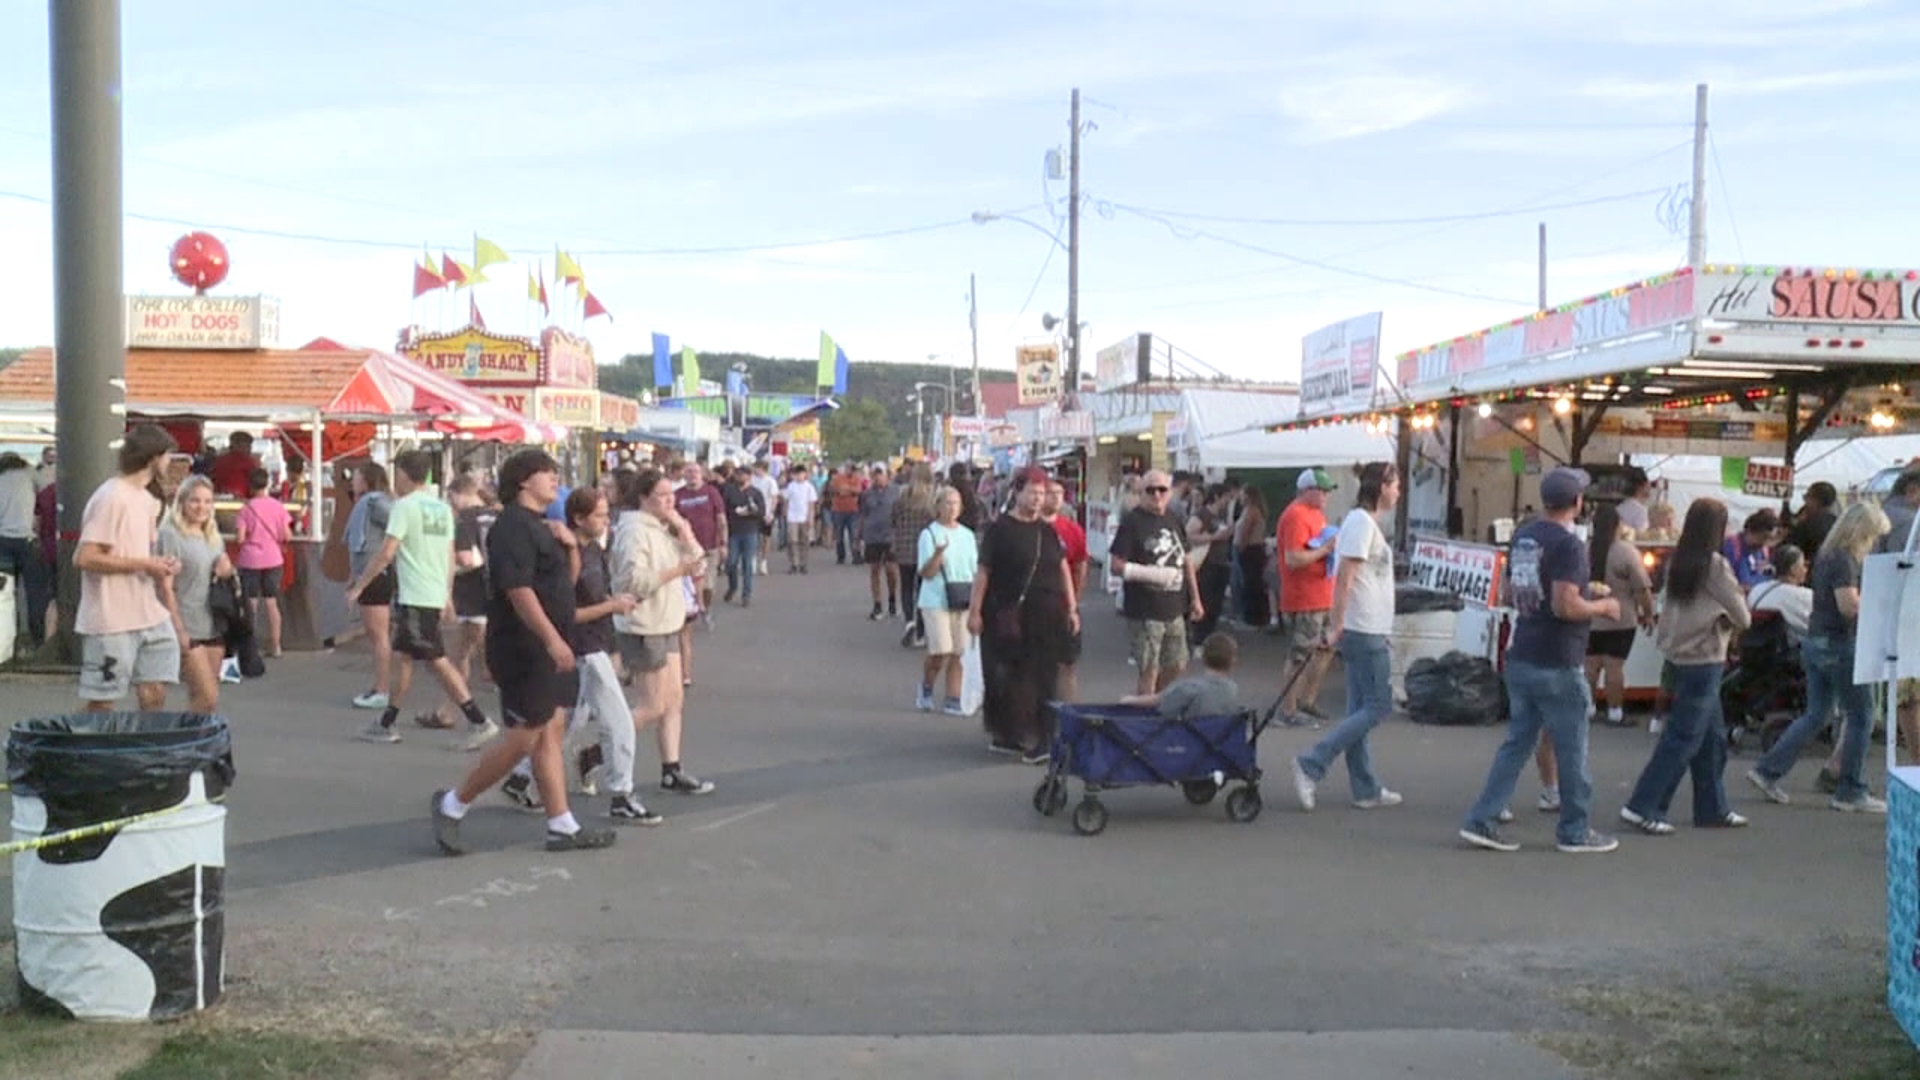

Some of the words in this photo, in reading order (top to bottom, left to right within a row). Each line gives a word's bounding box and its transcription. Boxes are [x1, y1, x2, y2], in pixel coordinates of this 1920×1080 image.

[1707, 274, 1760, 315] Hot
[144, 313, 179, 329] HOT
[191, 314, 240, 331] DOGS
[415, 352, 466, 372] CANDY
[479, 352, 528, 373] SHACK
[1747, 463, 1793, 483] CASH
[1745, 480, 1789, 497] ONLY
[1410, 560, 1433, 588] HOT
[1434, 565, 1492, 601] SAUSAGE
